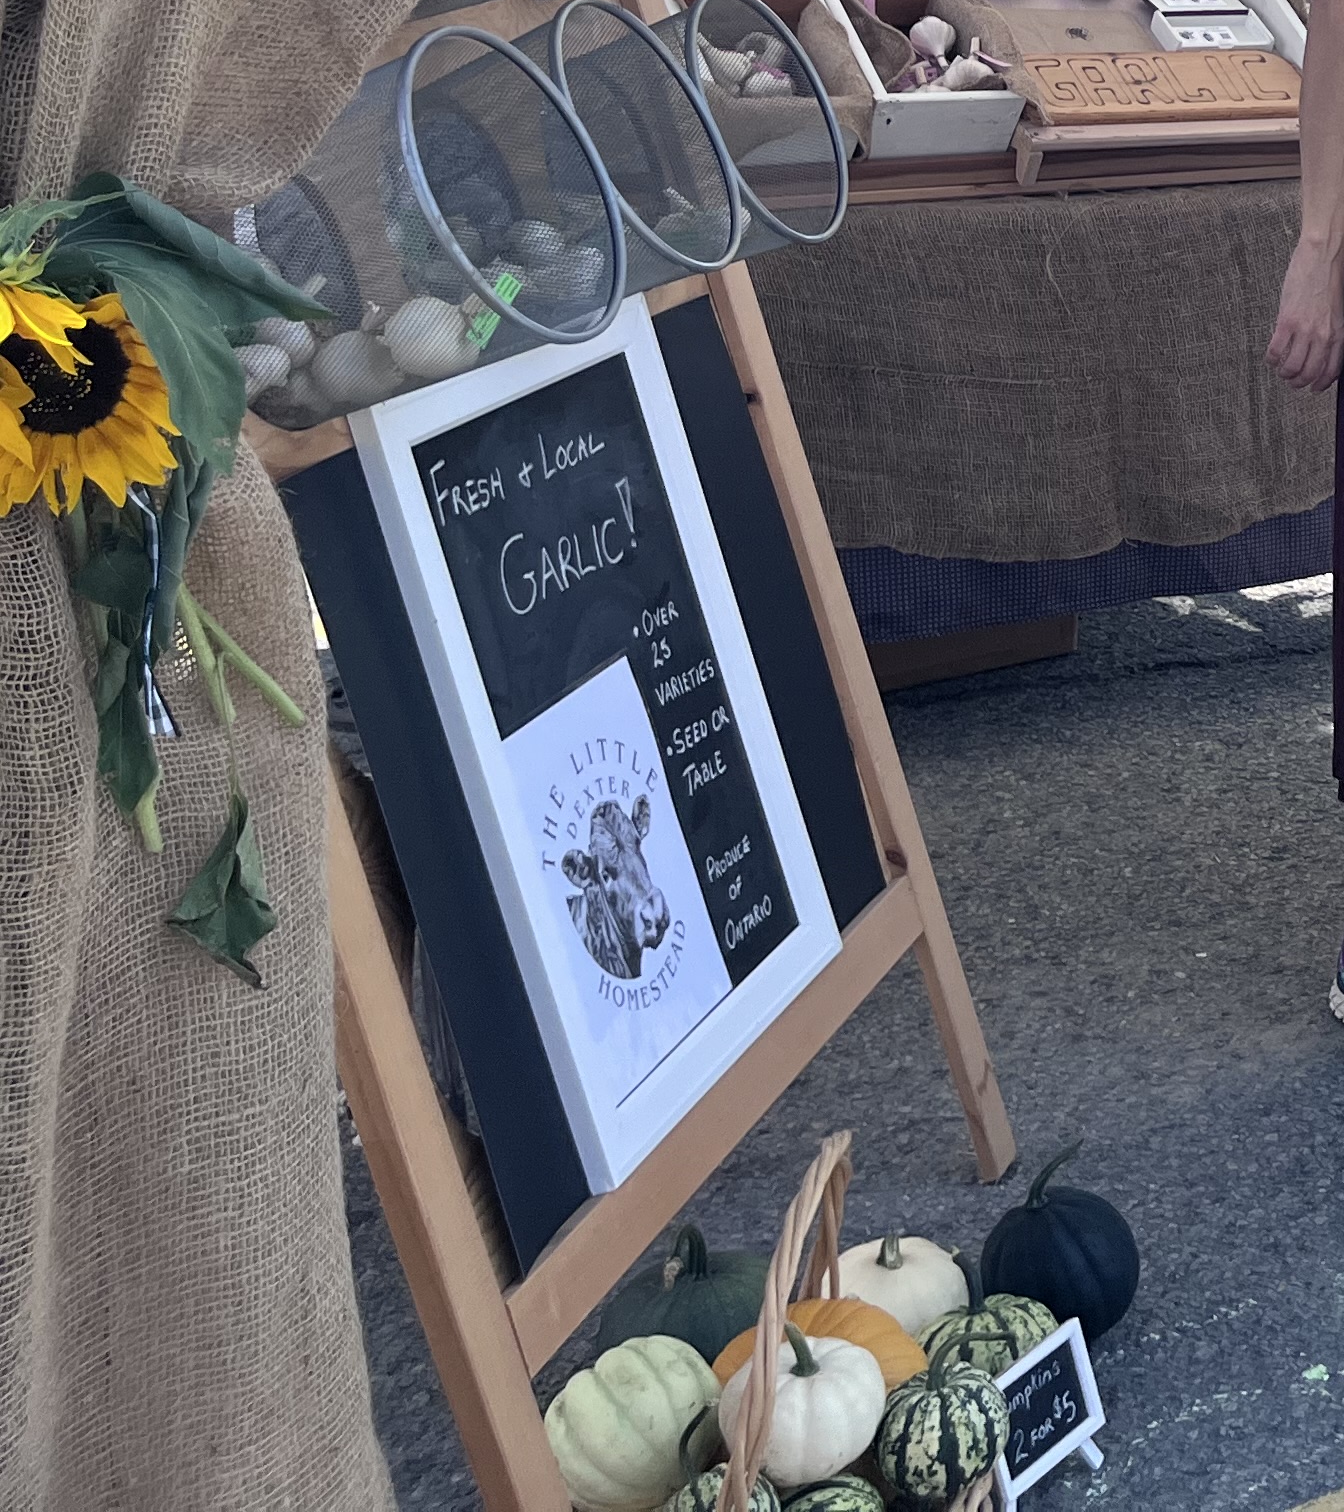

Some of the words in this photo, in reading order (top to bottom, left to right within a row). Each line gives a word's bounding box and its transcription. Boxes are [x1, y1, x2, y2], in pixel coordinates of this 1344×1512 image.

[1023, 53, 1292, 109] GARLIC
[430, 458, 506, 527] FRESH
[537, 431, 605, 480] LOCAL
[500, 475, 638, 616] GARLIC!
[642, 600, 680, 637] OVER
[651, 638, 672, 669] 25
[654, 657, 716, 708] VARIETIES
[672, 717, 708, 756] SEED
[711, 705, 731, 732] OR
[682, 749, 728, 797] TABLE
[542, 783, 566, 872] THE
[569, 737, 659, 794] LITTLE
[566, 775, 631, 840] DEXTER
[728, 875, 743, 902] OF
[724, 894, 773, 950] ONTARIO
[598, 918, 687, 1013] HOMESTEAD
[1008, 1359, 1062, 1414] mpkins
[1013, 1428, 1029, 1465] 2
[1052, 1389, 1077, 1424] $5
